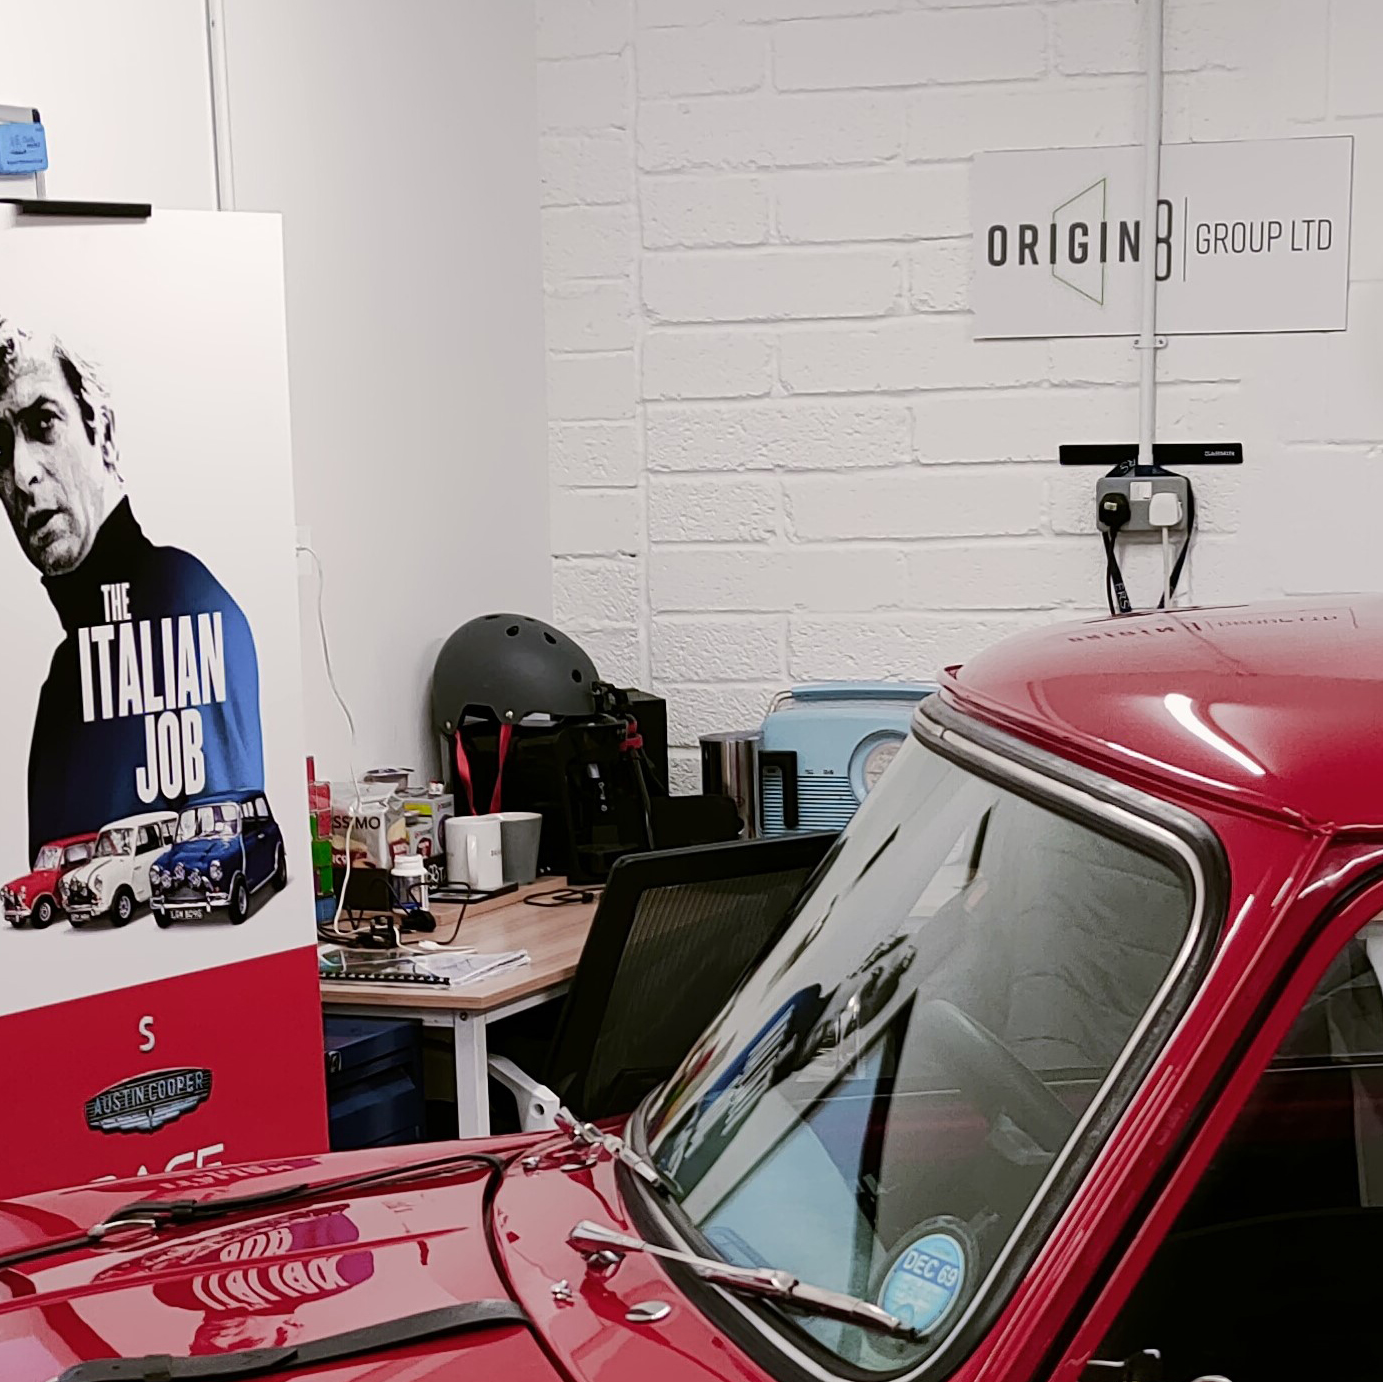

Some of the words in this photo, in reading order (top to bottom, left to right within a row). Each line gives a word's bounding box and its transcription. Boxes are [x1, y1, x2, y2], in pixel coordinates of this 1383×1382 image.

[1195, 220, 1283, 255] GROUP
[1290, 218, 1333, 252] LTD
[100, 582, 132, 623] THE
[77, 611, 227, 723] ITALIAN
[135, 708, 206, 804] JOB
[333, 814, 381, 830] SSMO
[138, 1015, 156, 1052] S
[93, 1086, 145, 1117] AUSTIN
[148, 1071, 204, 1101] COOPER
[903, 1250, 940, 1278] DEC
[937, 1264, 958, 1287] 69
